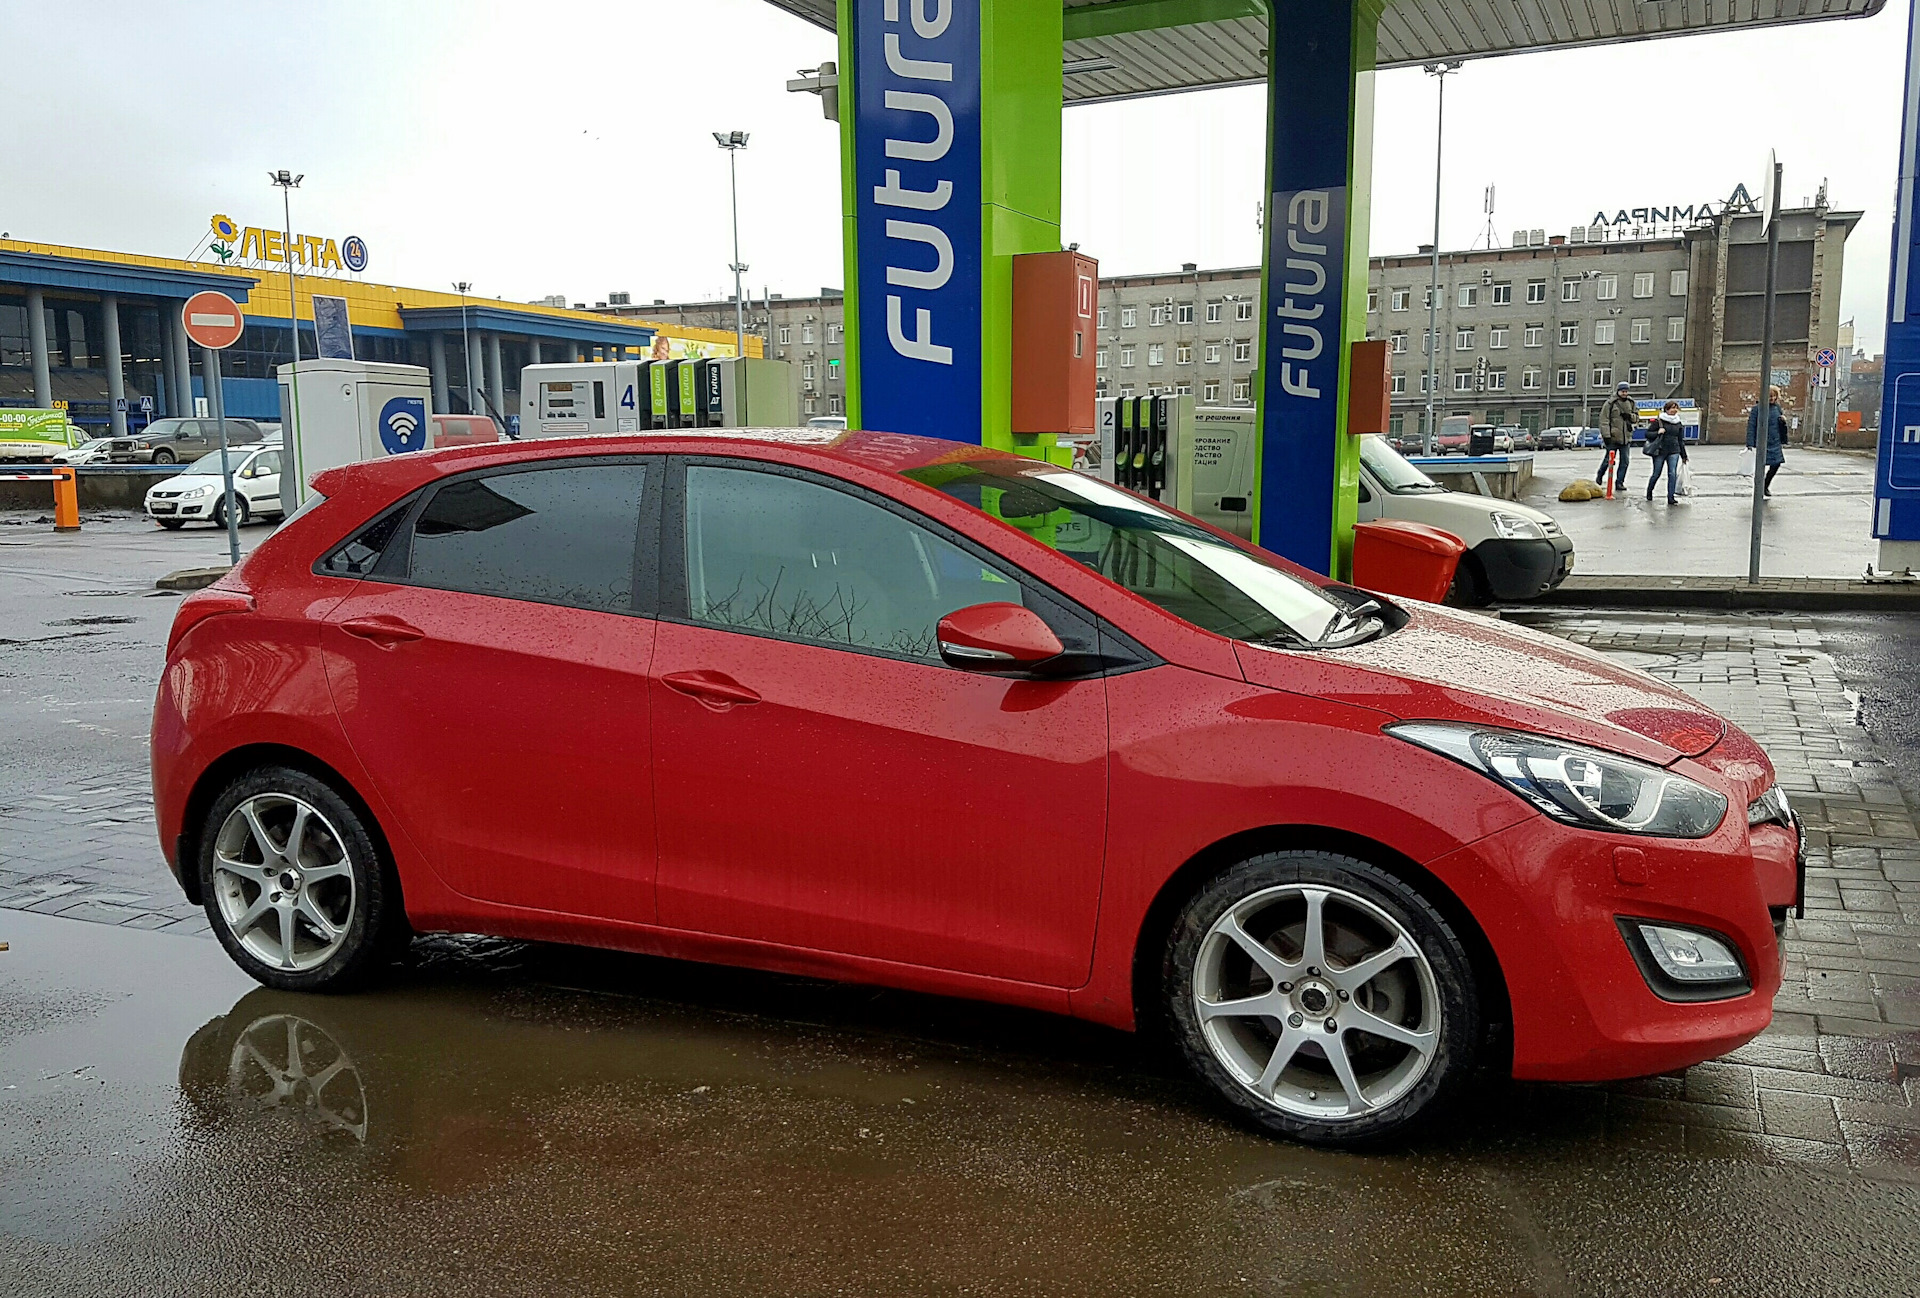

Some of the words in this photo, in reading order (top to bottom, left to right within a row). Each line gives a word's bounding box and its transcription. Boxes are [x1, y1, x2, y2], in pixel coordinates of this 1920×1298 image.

[240, 226, 343, 270] ЛЕНТА
[350, 242, 361, 257] 24
[1277, 189, 1329, 399] Futura
[682, 367, 690, 396] Futura
[710, 366, 719, 395] Futura
[620, 384, 635, 410] 4
[1103, 411, 1113, 426] 2
